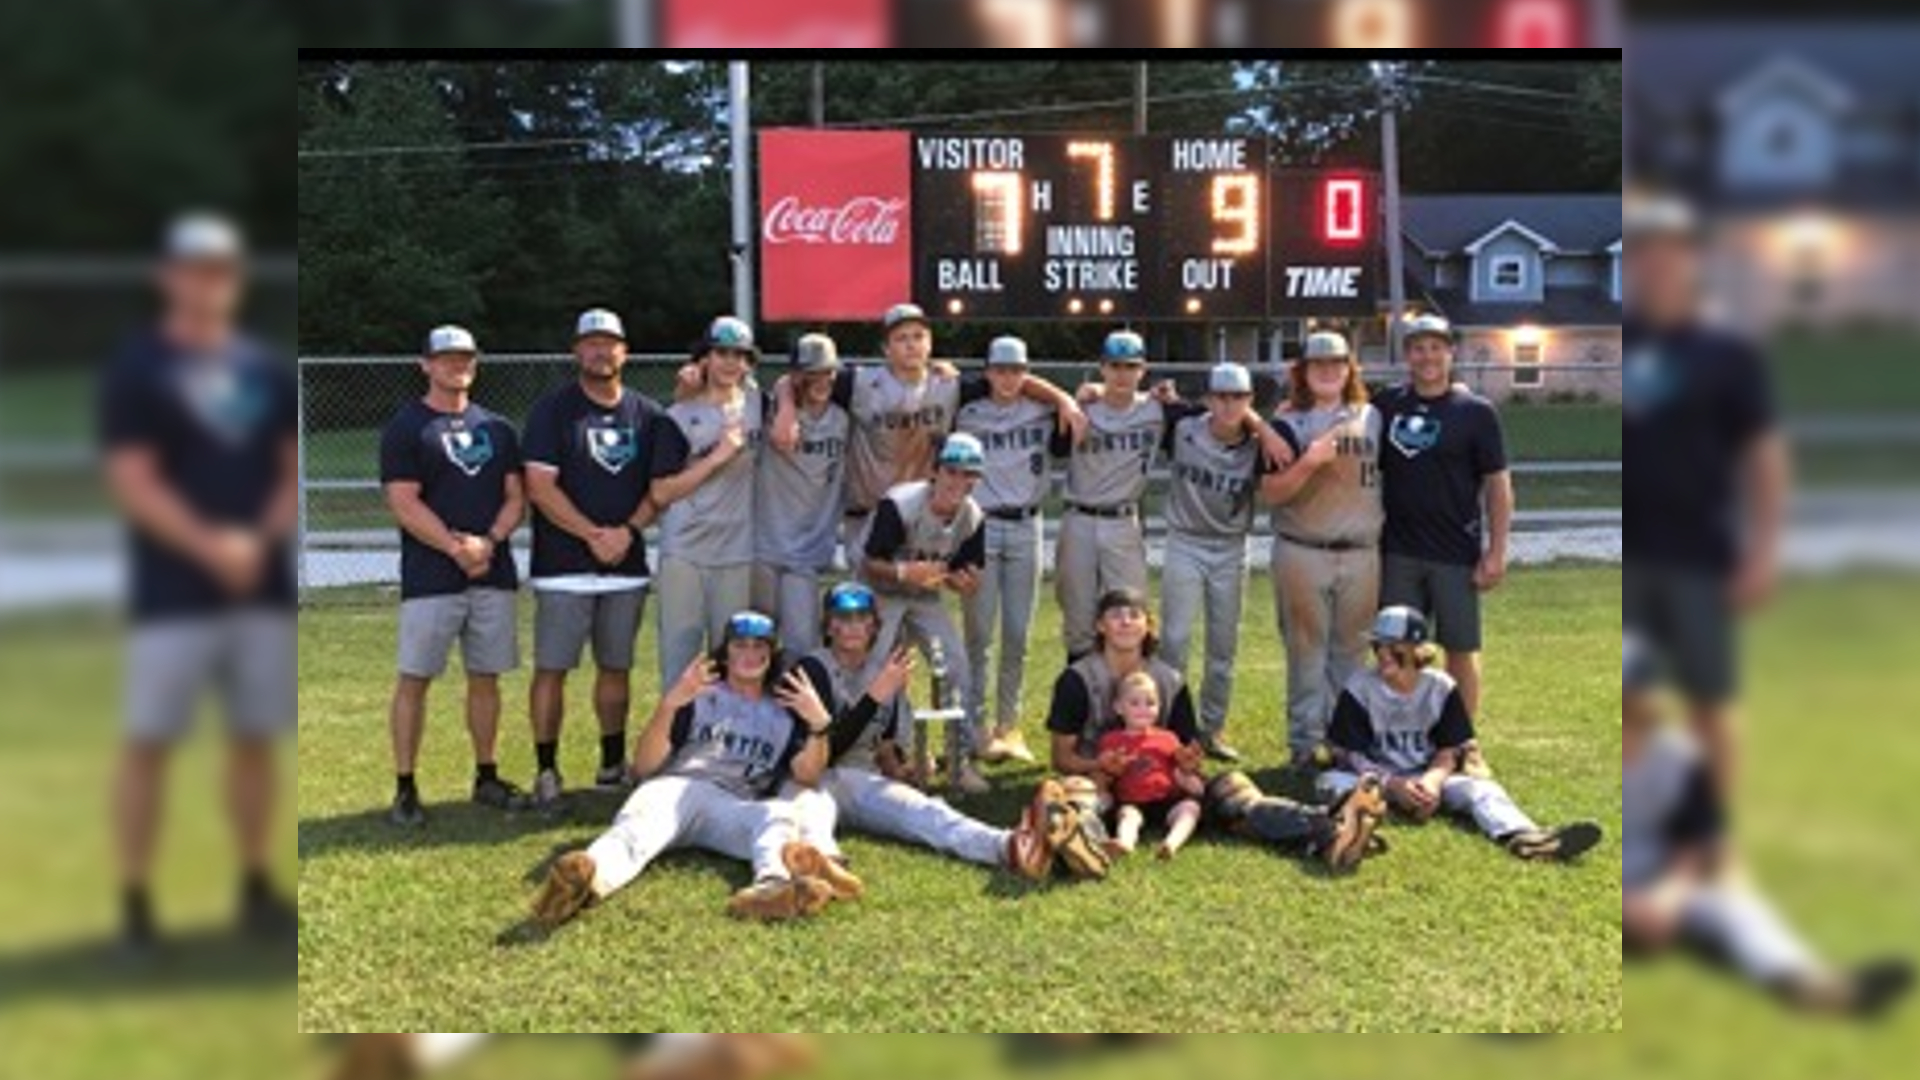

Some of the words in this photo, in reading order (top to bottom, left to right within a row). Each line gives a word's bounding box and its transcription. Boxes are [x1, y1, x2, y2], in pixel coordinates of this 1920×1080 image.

[917, 137, 1024, 169] VISITOR
[1172, 138, 1247, 169] HOME
[1031, 180, 1052, 212] H
[1066, 140, 1115, 221] 7
[1132, 180, 1150, 213] E
[971, 171, 1023, 255] 7
[1210, 173, 1259, 255] 9
[1325, 178, 1364, 241] 0
[1046, 225, 1136, 256] INNING
[937, 258, 1004, 290] BALL
[1044, 258, 1139, 290] STRIKE
[1181, 258, 1236, 289] OUT
[1285, 266, 1362, 298] TIME
[1030, 452, 1043, 476] 8
